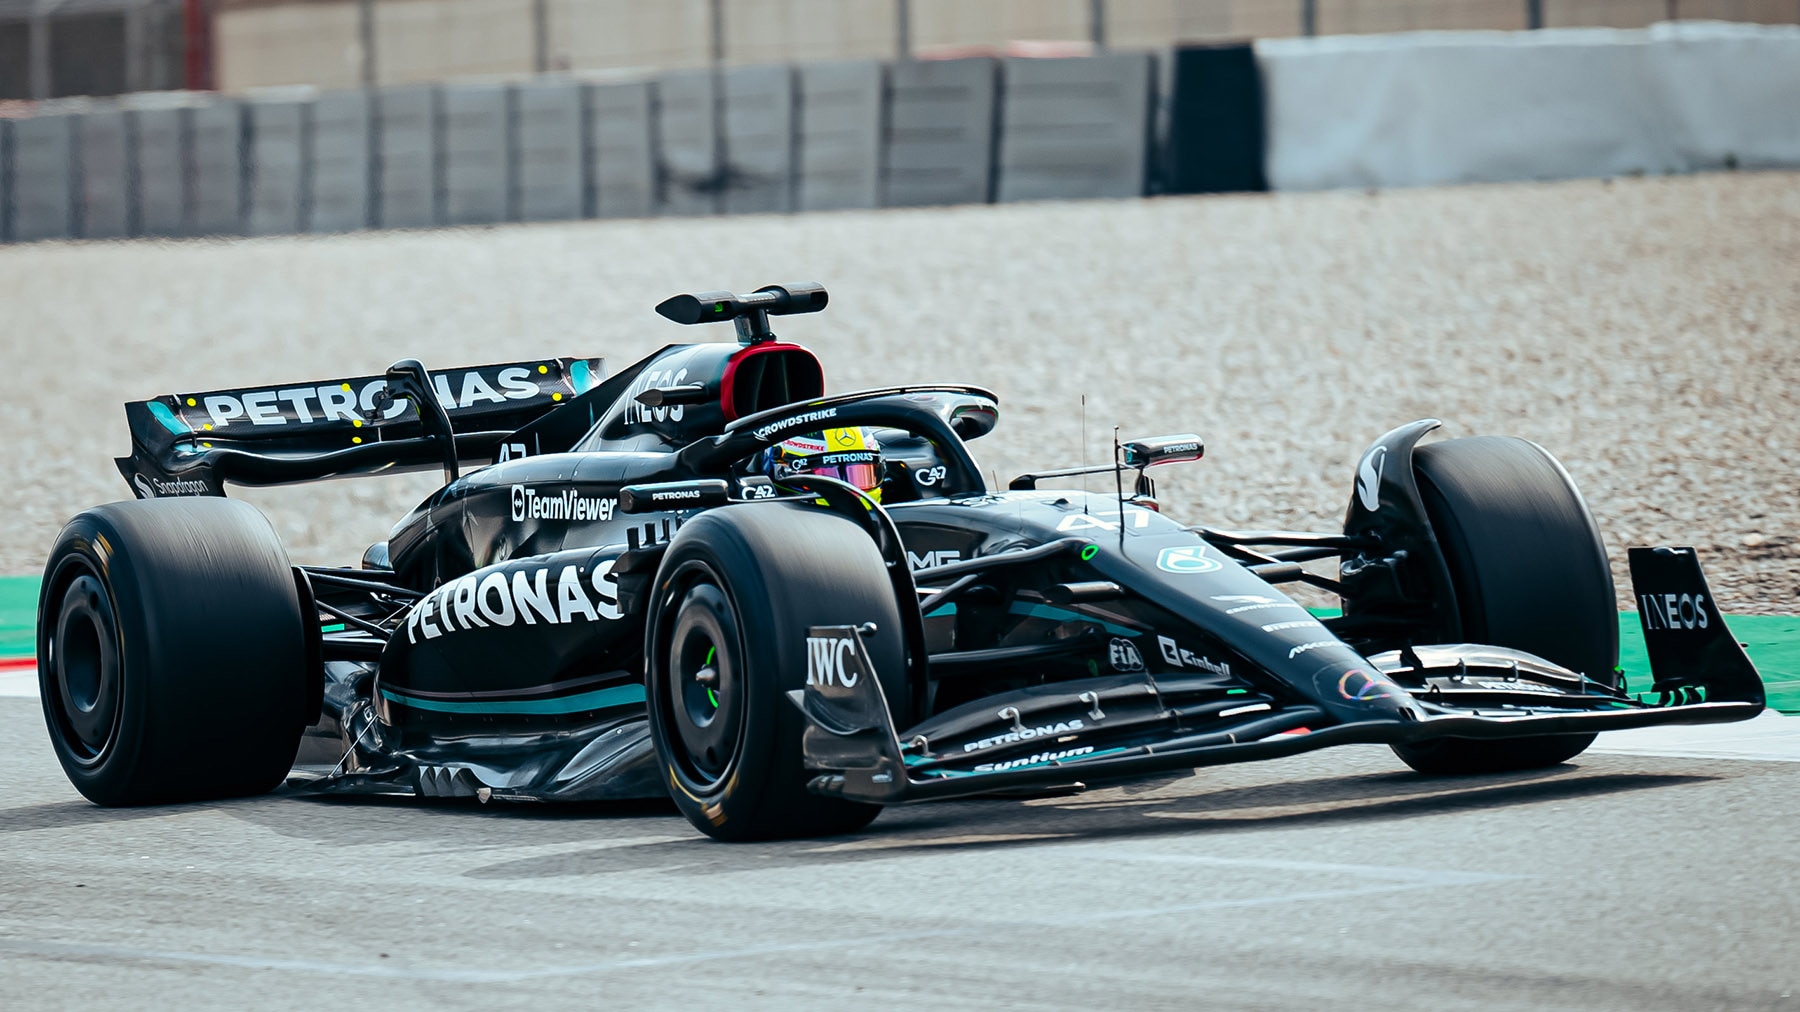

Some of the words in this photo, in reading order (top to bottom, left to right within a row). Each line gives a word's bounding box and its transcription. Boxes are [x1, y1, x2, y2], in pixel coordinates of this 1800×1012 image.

[624, 367, 688, 425] INEOS
[757, 407, 838, 439] CROWDSTRIKE
[823, 452, 874, 465] PETRONAS
[152, 476, 209, 498] Snapdragon
[652, 489, 701, 501] PETRONAS
[525, 487, 618, 521] TeamViewer
[1056, 509, 1150, 532] 47
[407, 559, 626, 645] PETRONAS
[1640, 592, 1709, 630] INEOS
[806, 637, 859, 688] IWC
[964, 718, 1085, 753] PETRONAS
[973, 745, 1095, 773] Suntium
